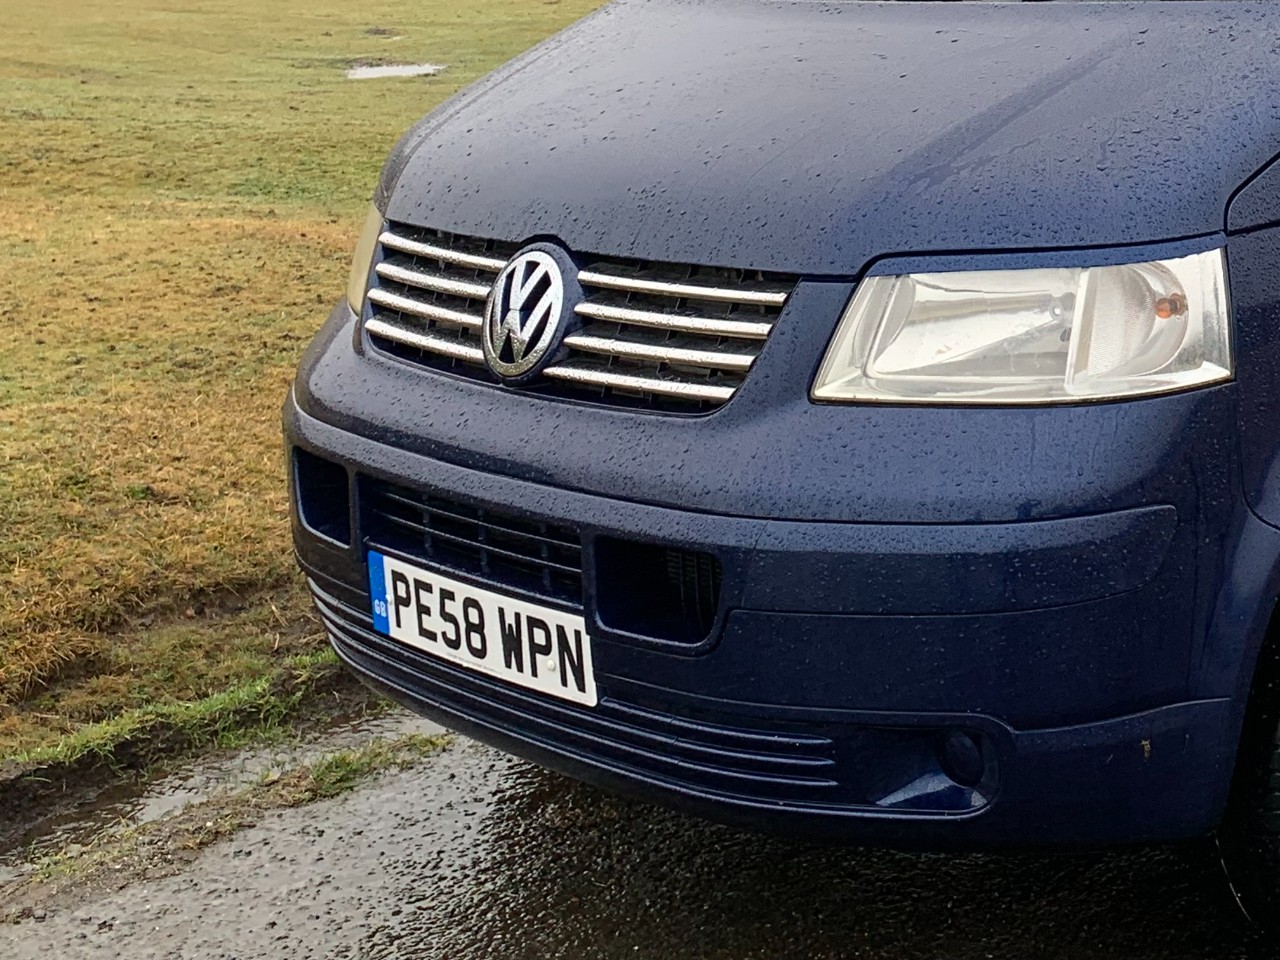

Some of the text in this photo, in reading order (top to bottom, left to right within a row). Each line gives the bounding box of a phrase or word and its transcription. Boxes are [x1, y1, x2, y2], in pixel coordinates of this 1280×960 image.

[374, 599, 387, 617] GB
[391, 569, 586, 693] PE58 WPN
